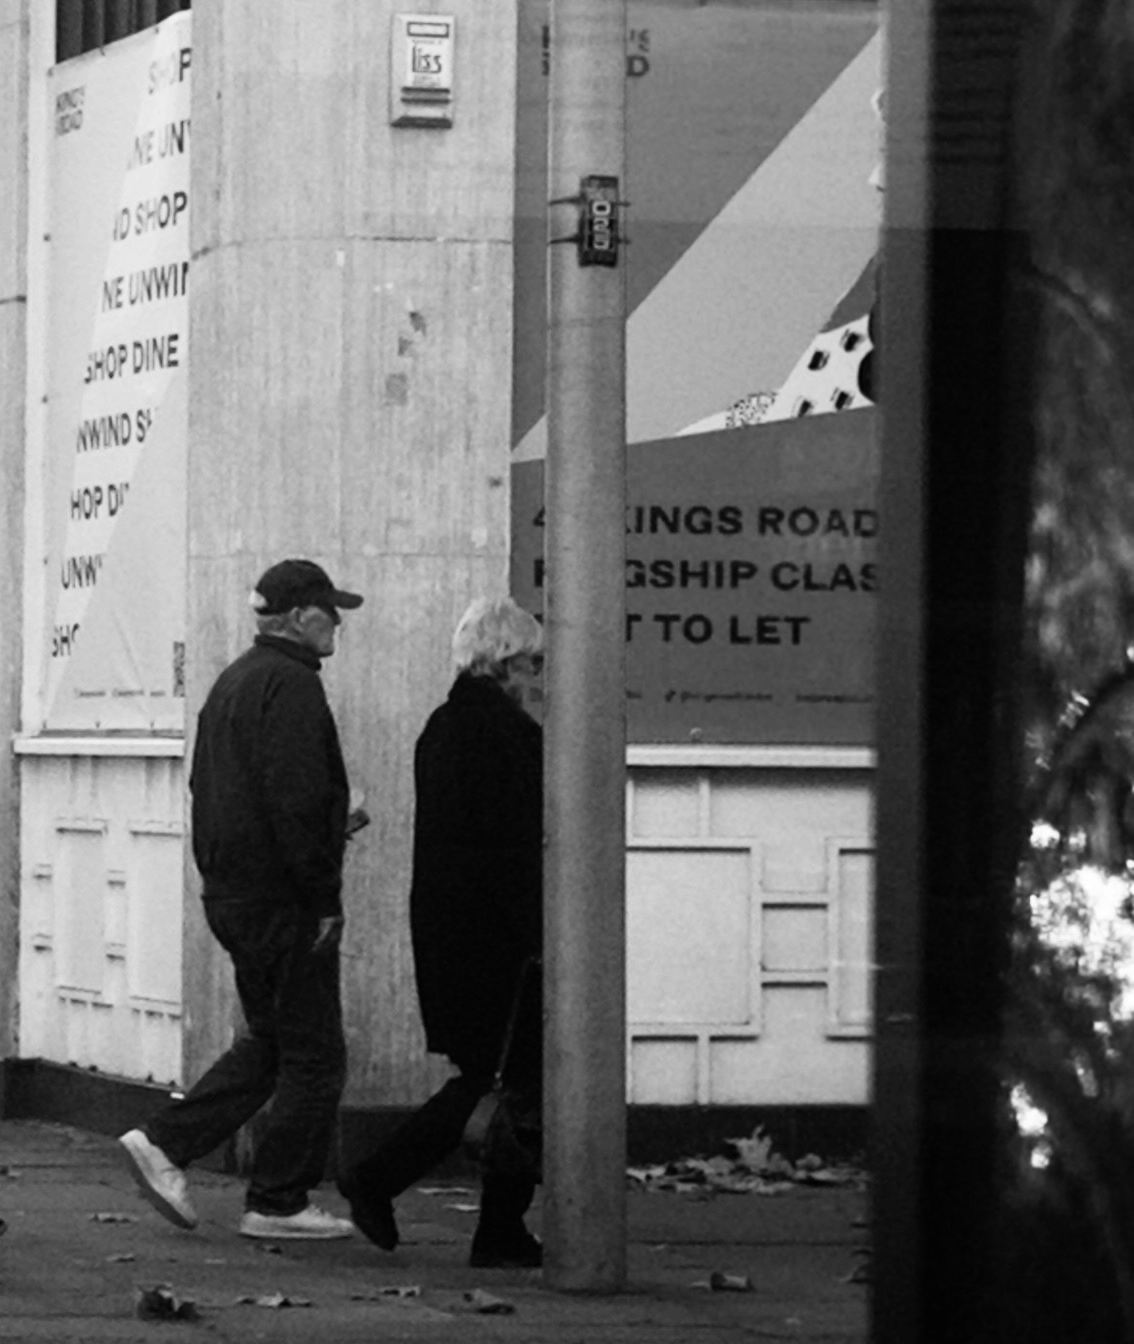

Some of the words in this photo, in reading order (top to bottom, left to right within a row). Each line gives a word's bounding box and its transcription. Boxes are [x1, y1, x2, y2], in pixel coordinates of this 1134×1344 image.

[134, 191, 188, 236] SHOP
[133, 333, 179, 374] DINE
[626, 506, 743, 536] INGS
[758, 507, 880, 538] ROAD
[653, 614, 713, 644] TO
[730, 615, 812, 645] LET
